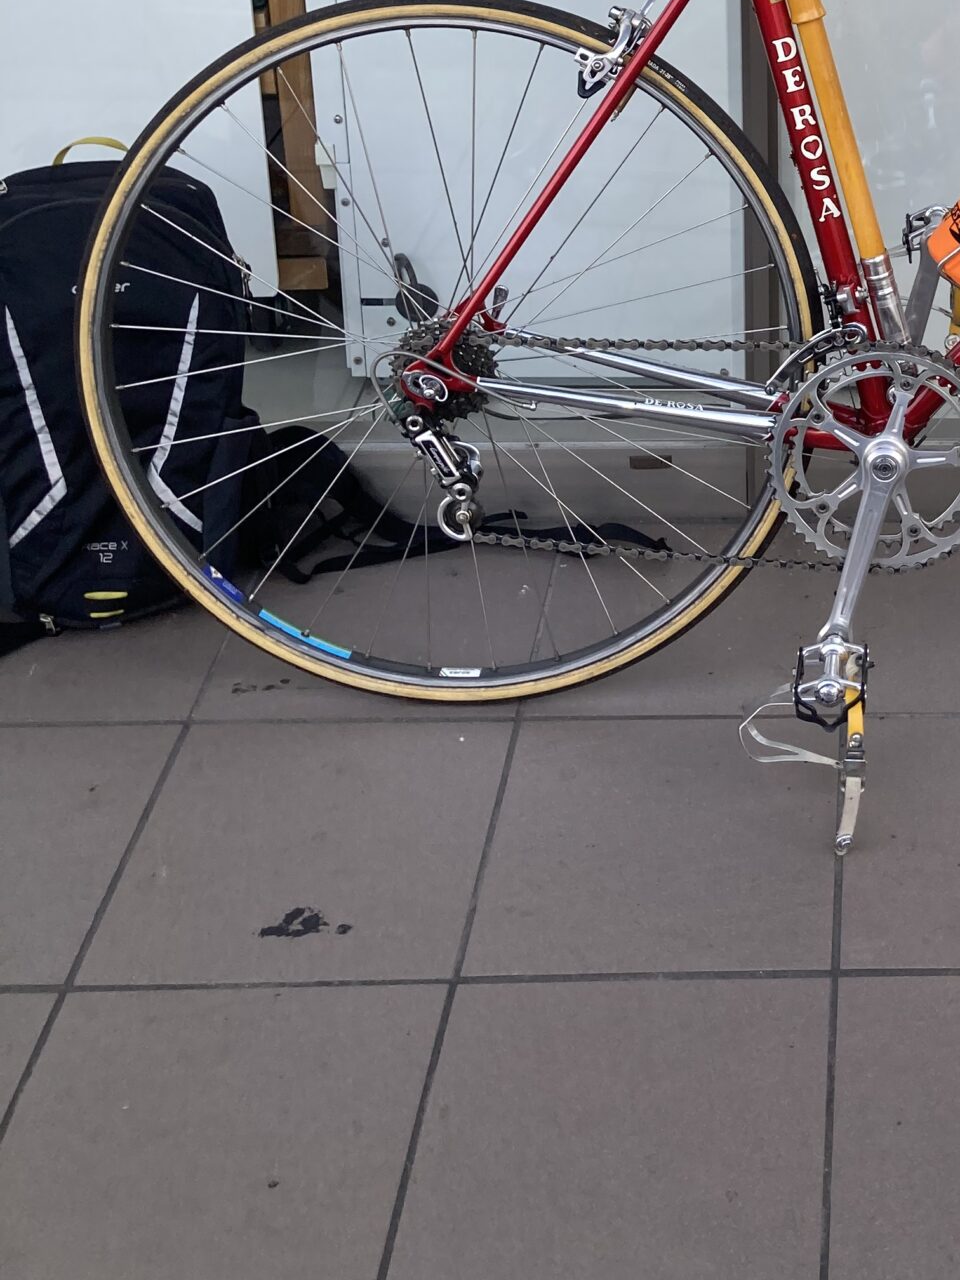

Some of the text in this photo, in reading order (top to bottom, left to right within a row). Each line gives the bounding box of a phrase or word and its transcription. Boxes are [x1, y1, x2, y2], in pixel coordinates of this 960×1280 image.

[772, 36, 841, 222] DE ROSA
[644, 398, 704, 412] DE ROSA
[99, 552, 113, 563] 12
